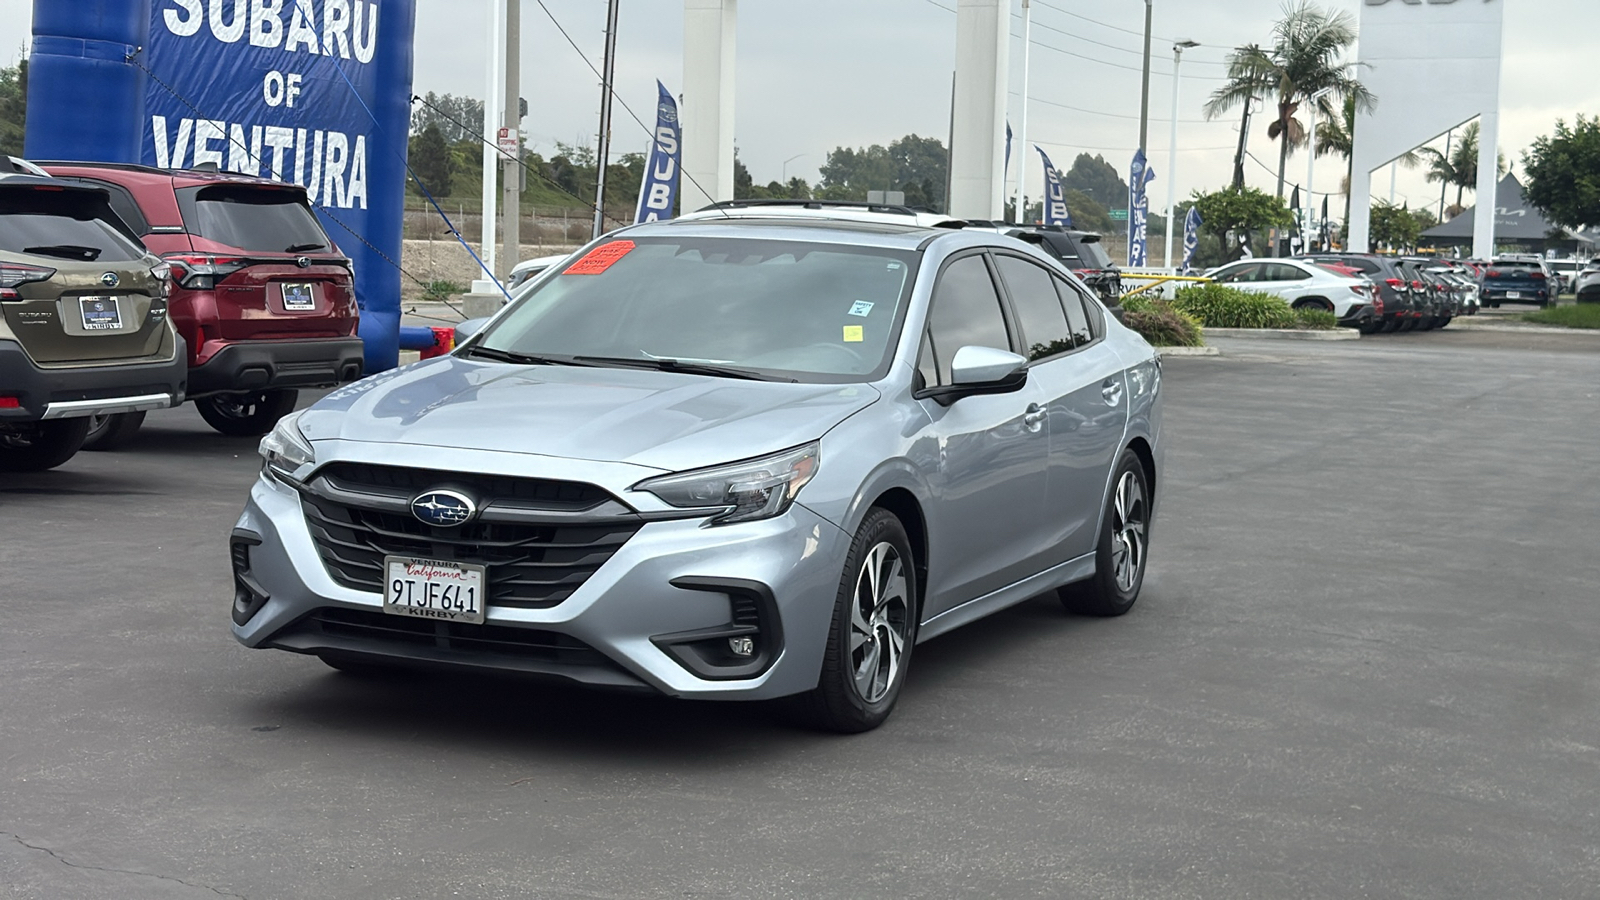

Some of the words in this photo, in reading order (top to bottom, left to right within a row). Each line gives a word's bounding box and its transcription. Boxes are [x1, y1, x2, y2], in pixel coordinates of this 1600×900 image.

[163, 0, 378, 64] SUBARU
[263, 70, 302, 108] OF
[152, 115, 368, 210] VENTURA
[406, 562, 467, 581] California
[410, 558, 460, 569] VENTURA
[392, 579, 477, 614] 9TJF641
[408, 608, 458, 620] KIRBY
